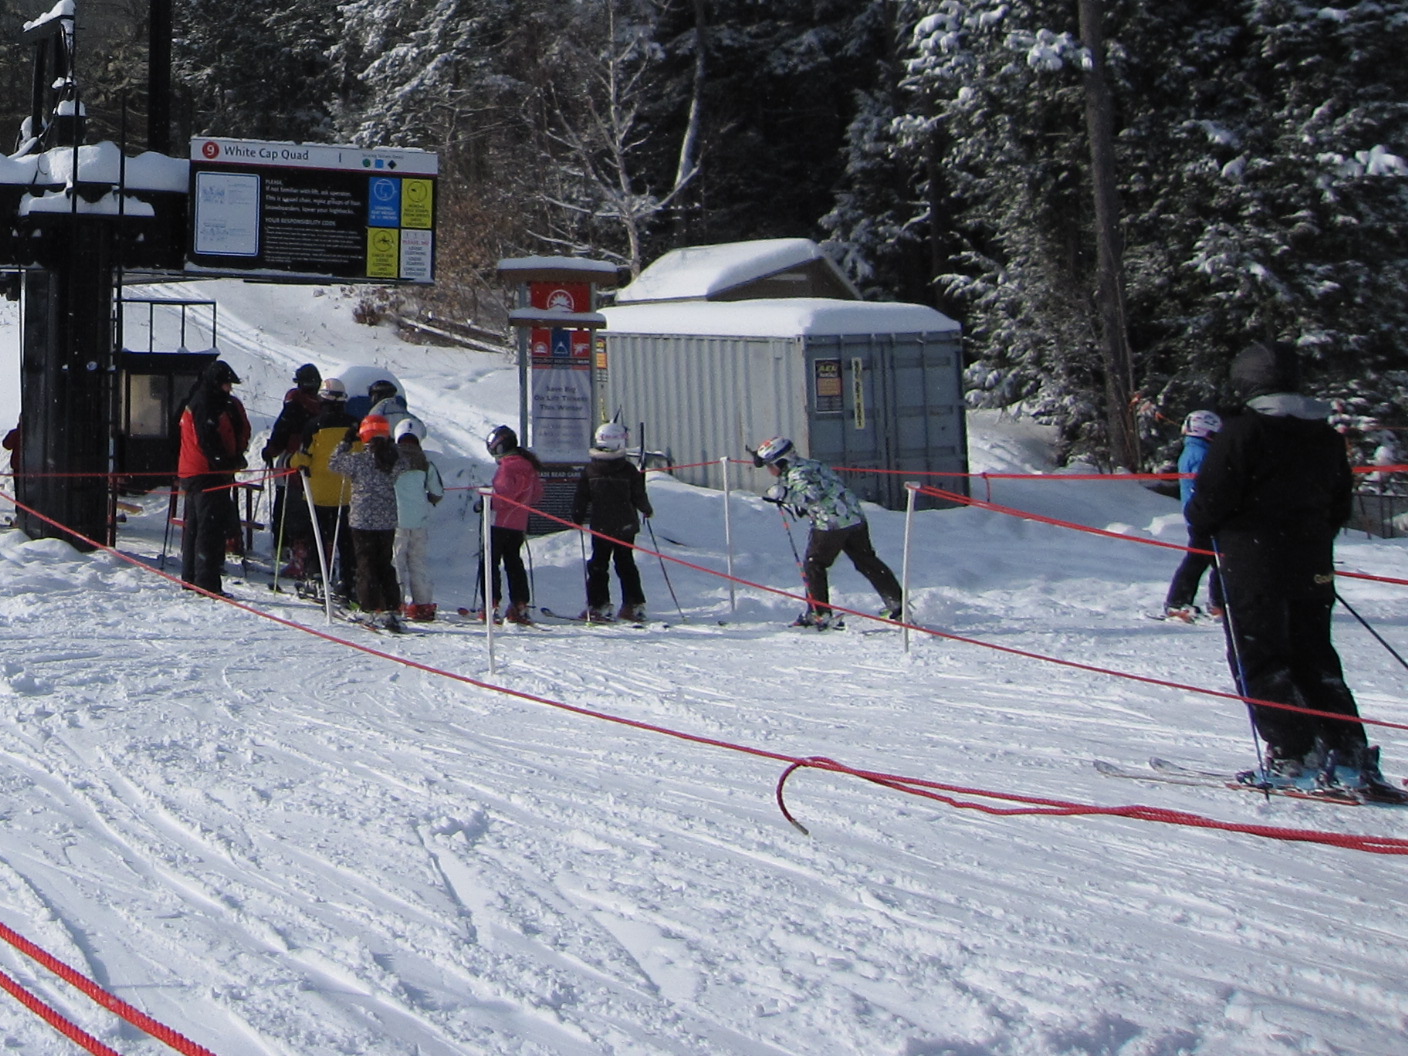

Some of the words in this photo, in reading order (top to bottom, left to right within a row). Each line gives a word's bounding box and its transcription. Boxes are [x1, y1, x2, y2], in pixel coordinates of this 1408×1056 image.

[206, 144, 215, 156] 9
[224, 145, 256, 158] White
[259, 148, 278, 161] Cap
[281, 149, 309, 160] Quad
